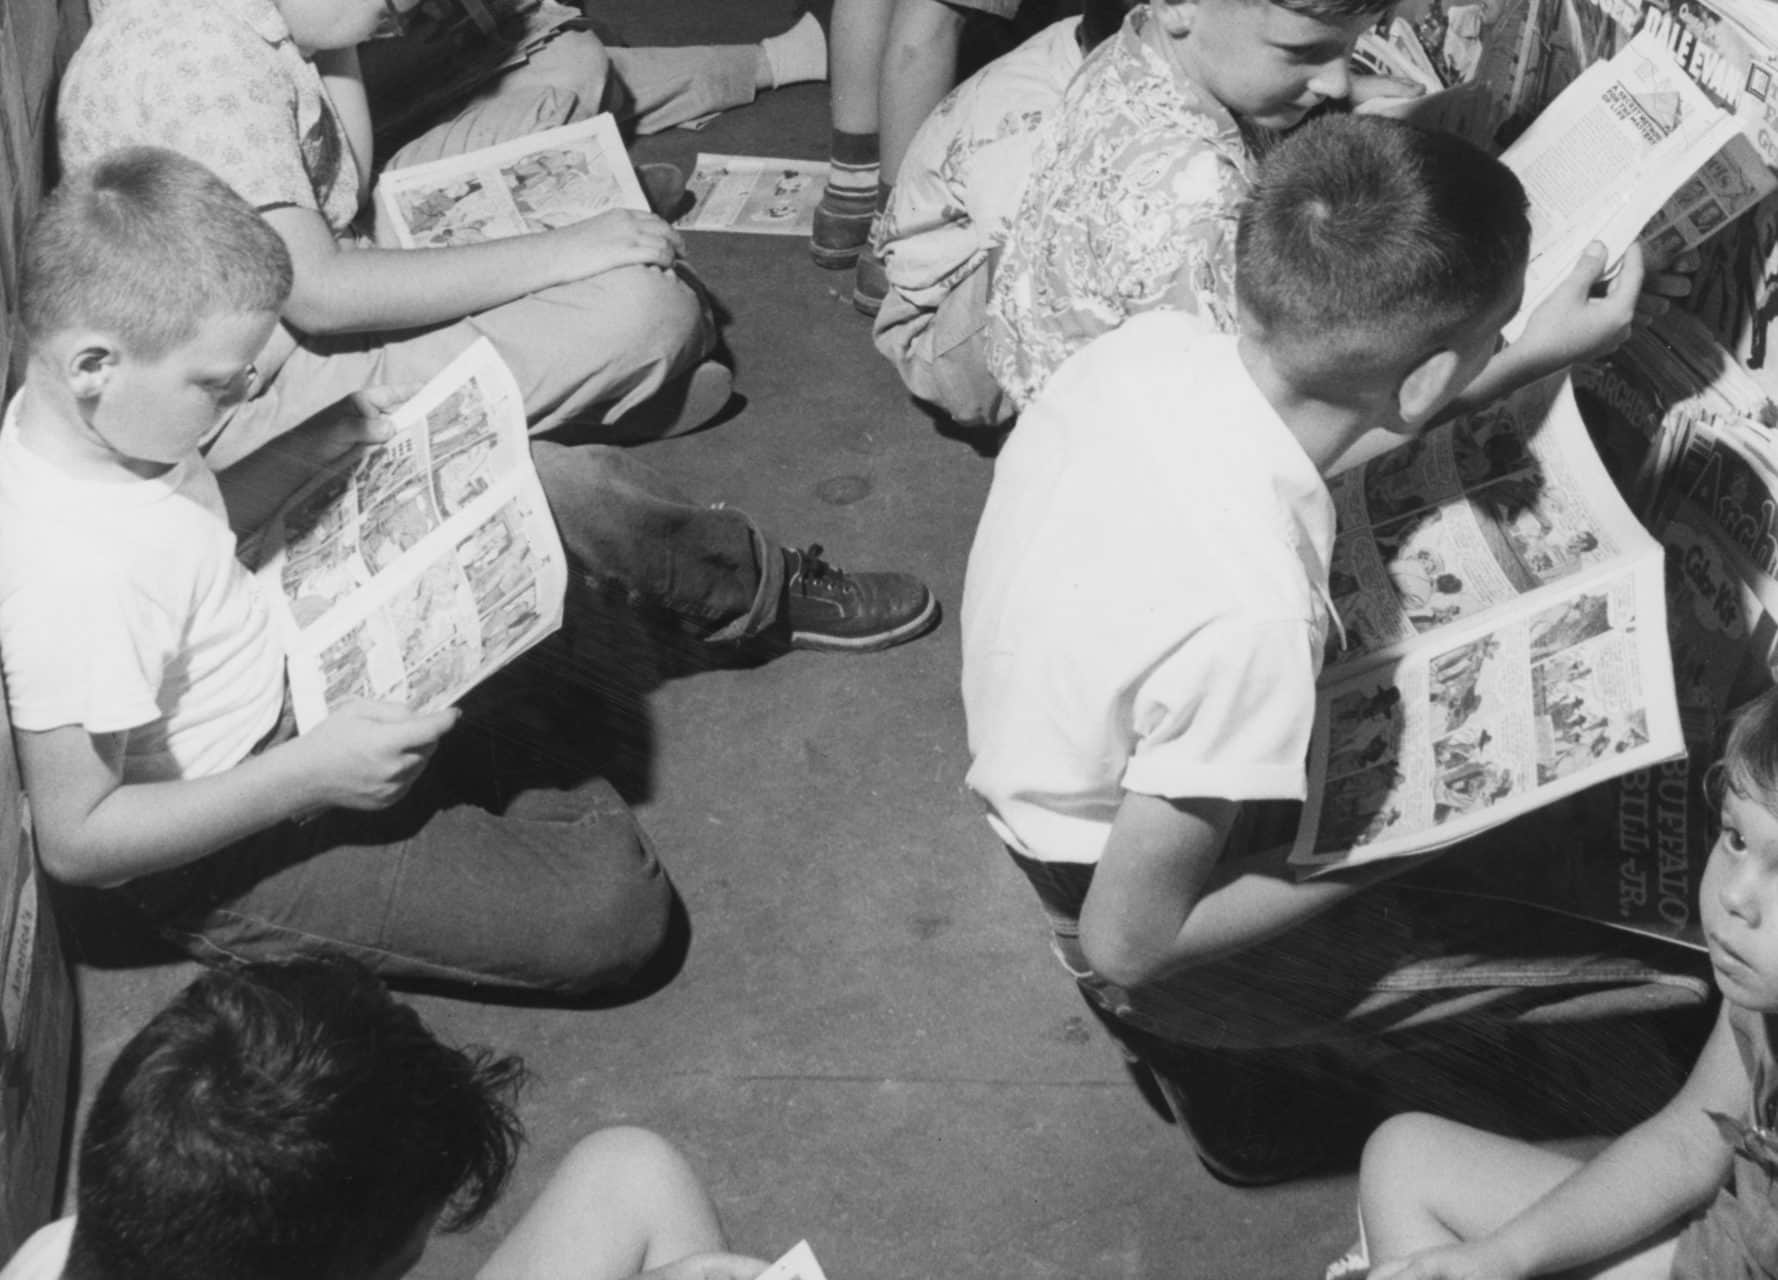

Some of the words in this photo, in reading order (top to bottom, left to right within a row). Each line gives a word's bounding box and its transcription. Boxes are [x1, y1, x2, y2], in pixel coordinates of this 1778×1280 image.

[1648, 4, 1696, 80] DALE
[1618, 770, 1651, 854] BILL
[1657, 760, 1690, 931] BUFFALO
